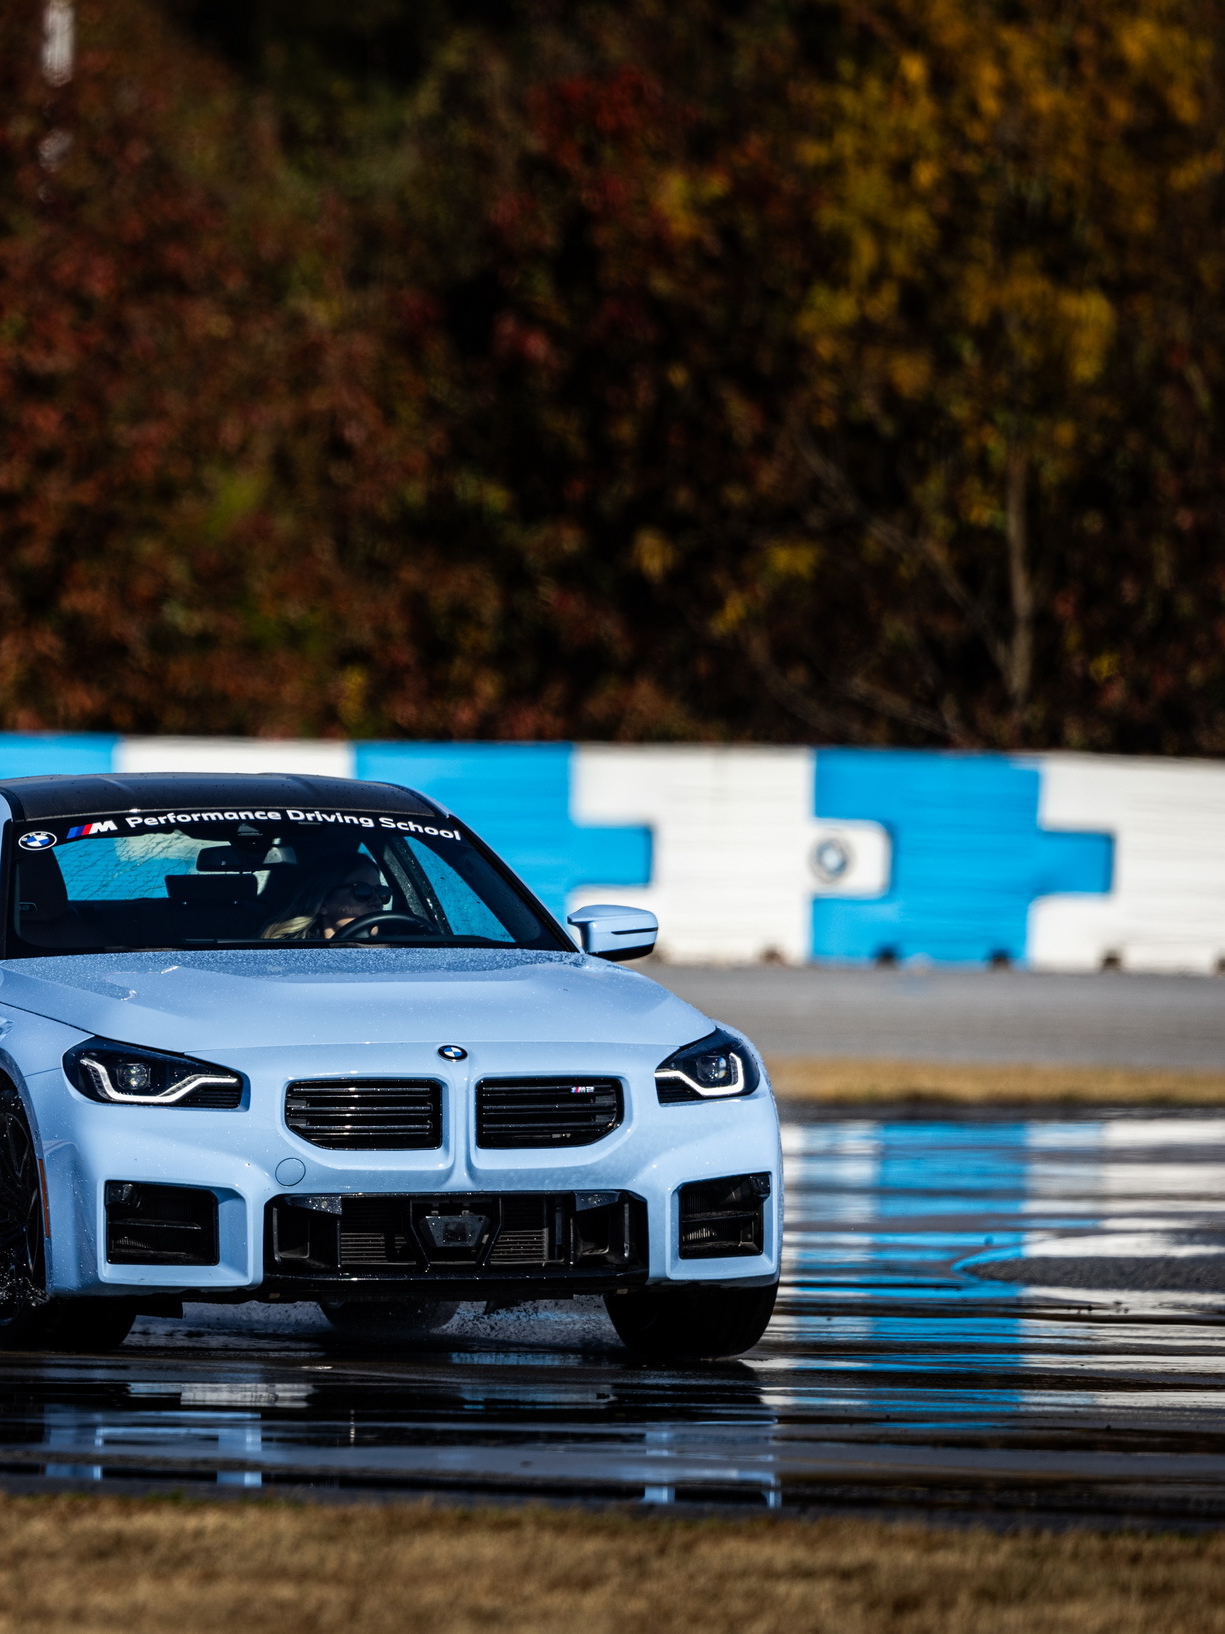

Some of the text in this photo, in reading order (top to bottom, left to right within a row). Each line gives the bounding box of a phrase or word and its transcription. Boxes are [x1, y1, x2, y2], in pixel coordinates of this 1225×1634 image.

[125, 810, 282, 828] Performance
[286, 809, 375, 828] Driving
[378, 817, 462, 841] School
